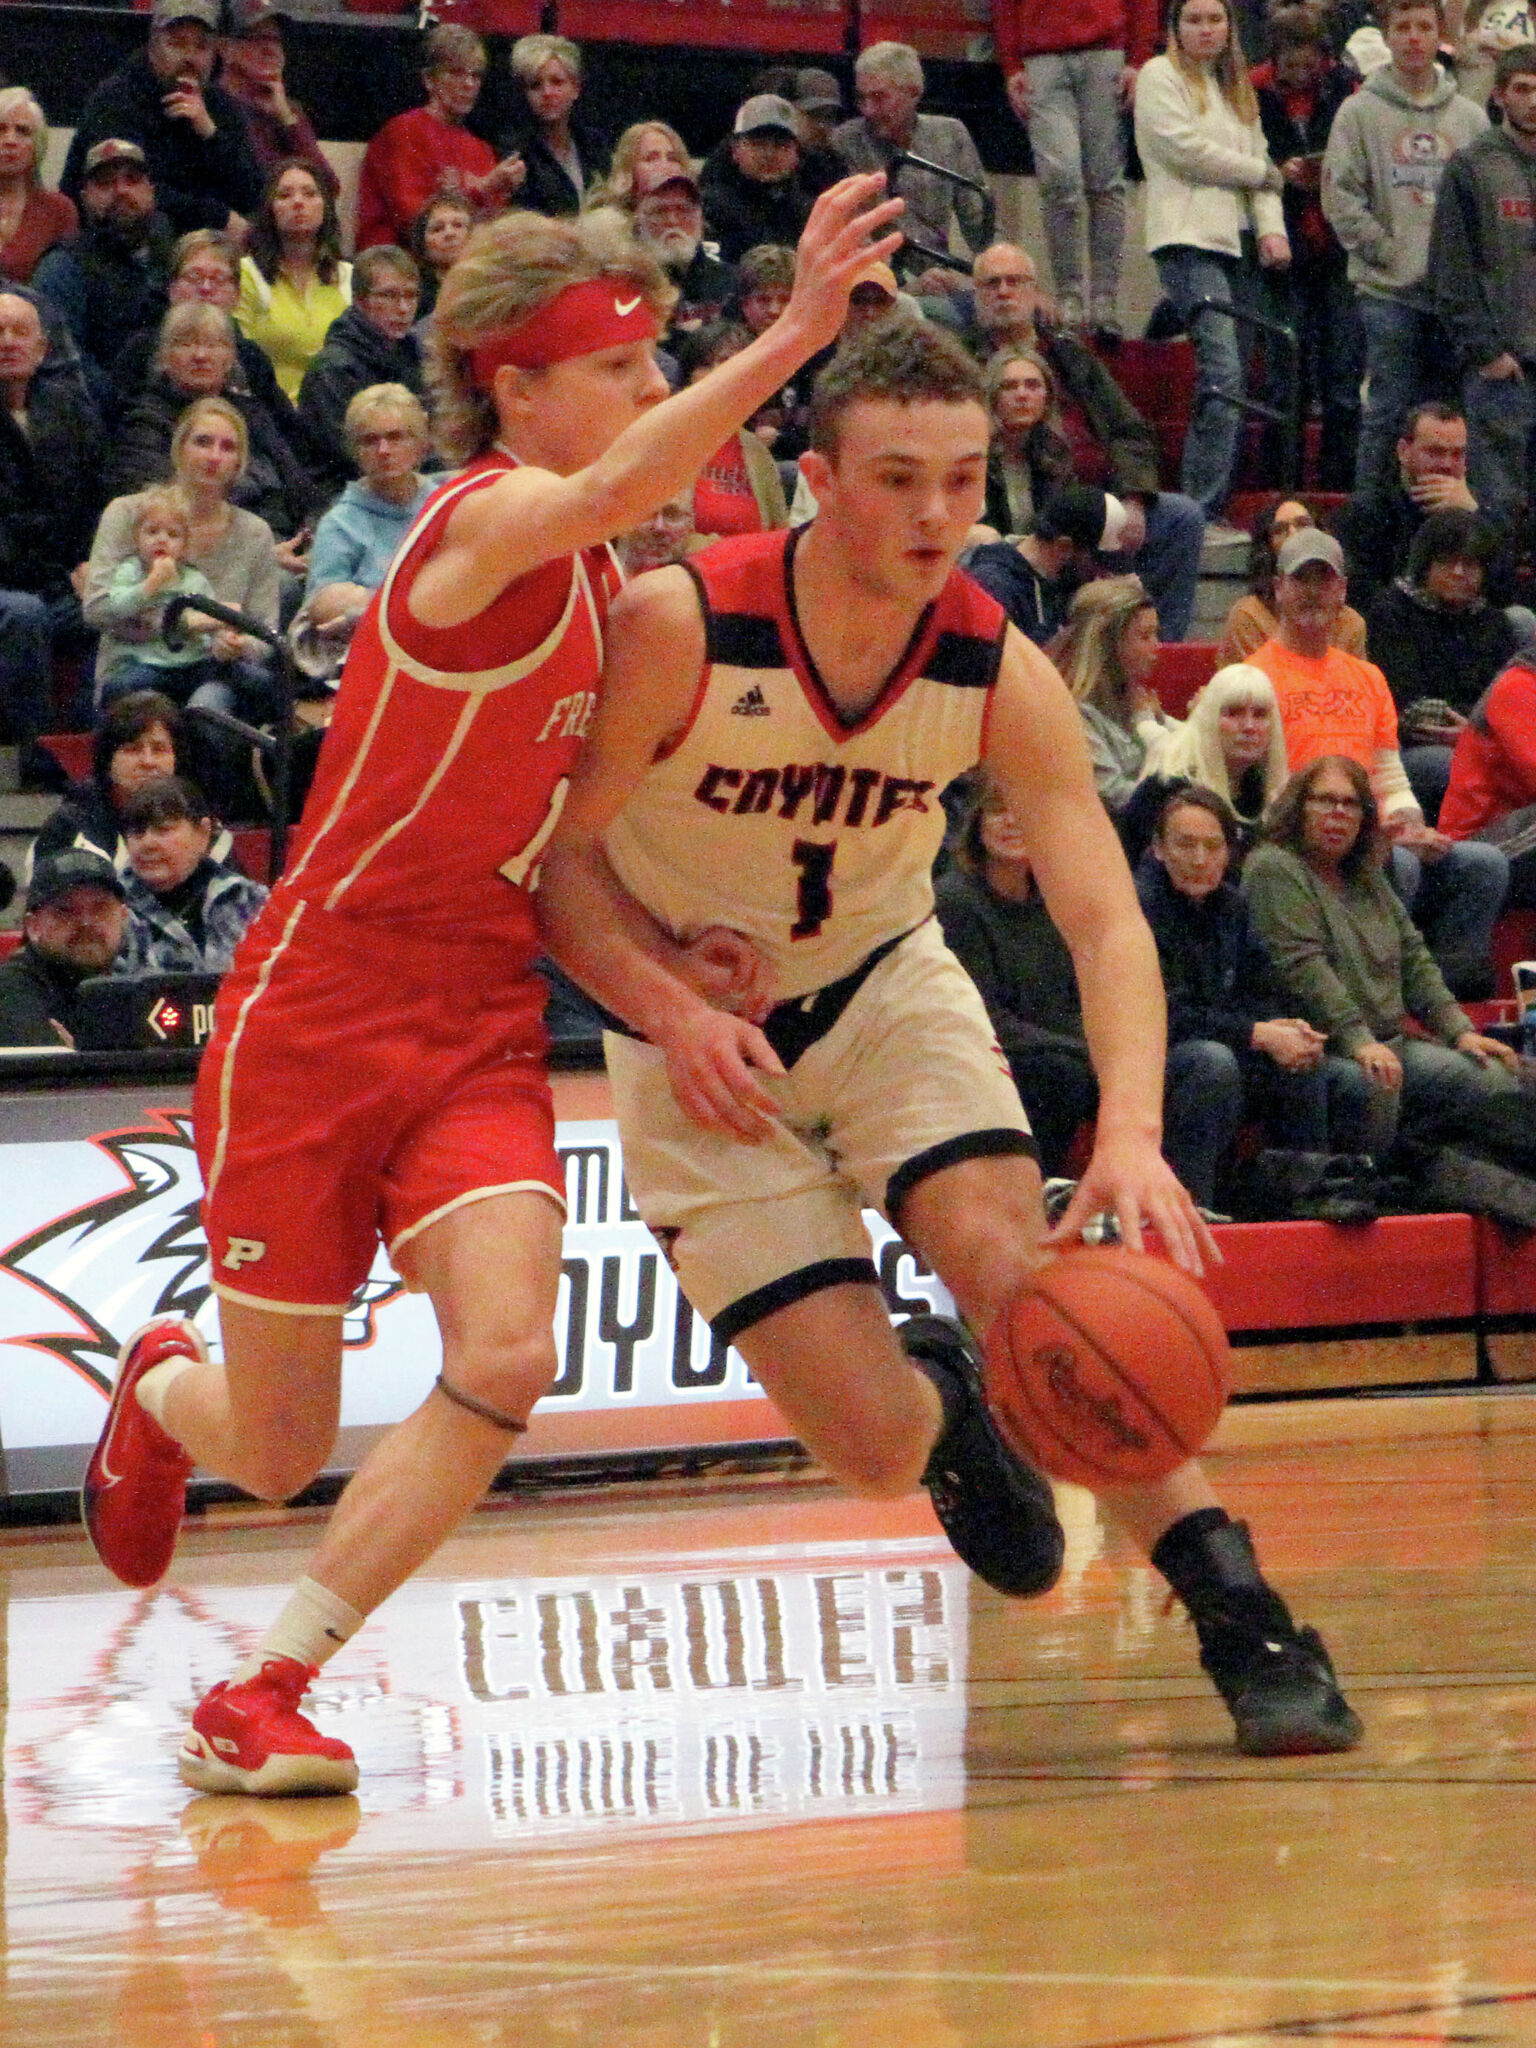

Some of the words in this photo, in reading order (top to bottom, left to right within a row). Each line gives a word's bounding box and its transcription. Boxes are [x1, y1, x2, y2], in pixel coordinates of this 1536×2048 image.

[535, 691, 598, 742] FRE
[694, 762, 937, 827] COYOTES
[790, 838, 837, 942] 1
[221, 1236, 267, 1271] P
